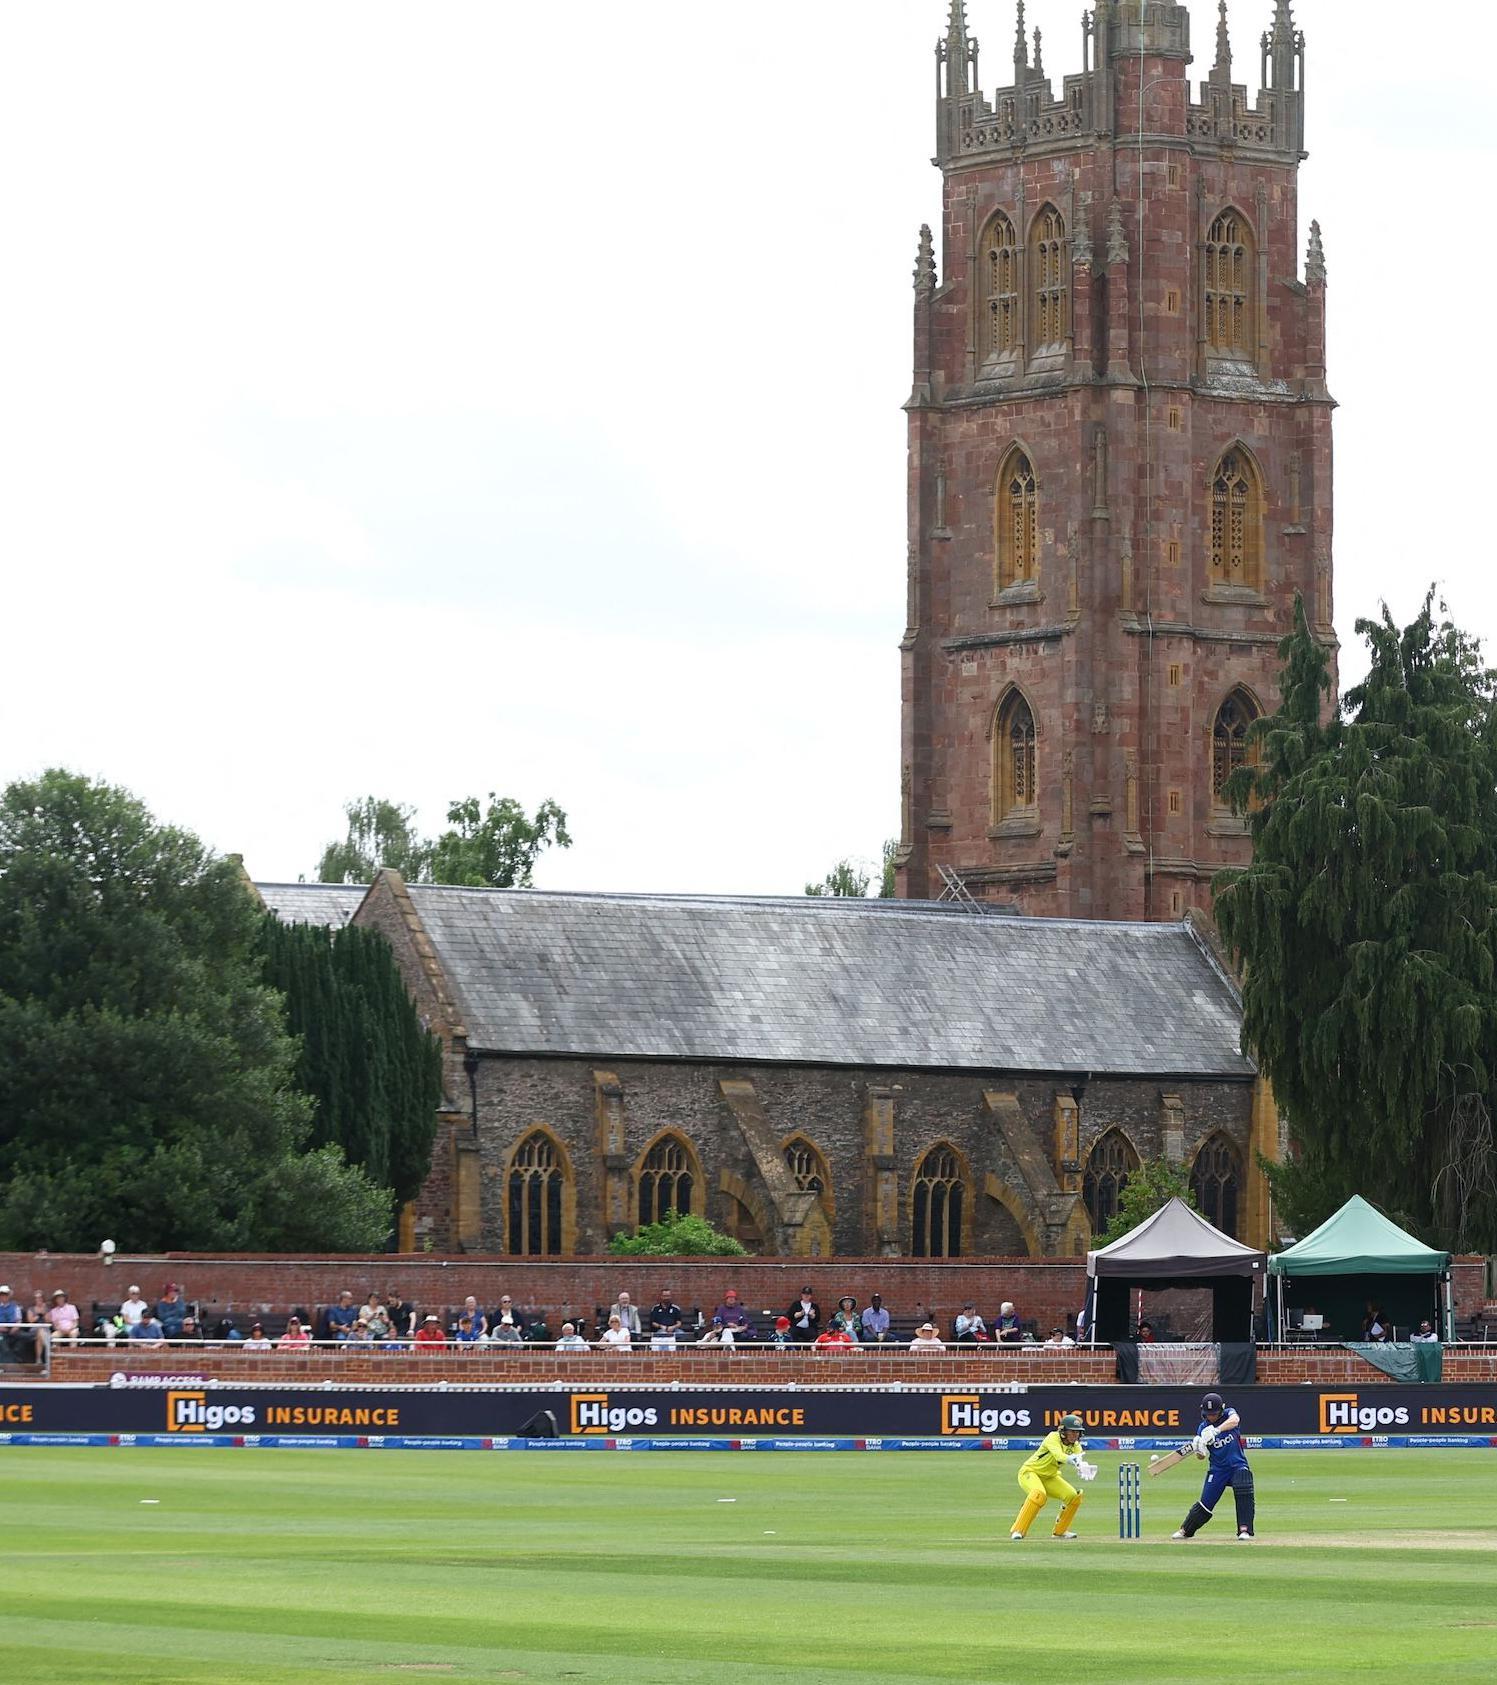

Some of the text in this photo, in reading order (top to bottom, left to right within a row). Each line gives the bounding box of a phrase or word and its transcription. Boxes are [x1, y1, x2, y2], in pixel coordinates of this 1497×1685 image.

[176, 1399, 399, 1430] Higos INSURANCE
[579, 1402, 805, 1431] Higos INSURANCE
[951, 1403, 1031, 1432] Higos
[1329, 1402, 1409, 1431] Higos
